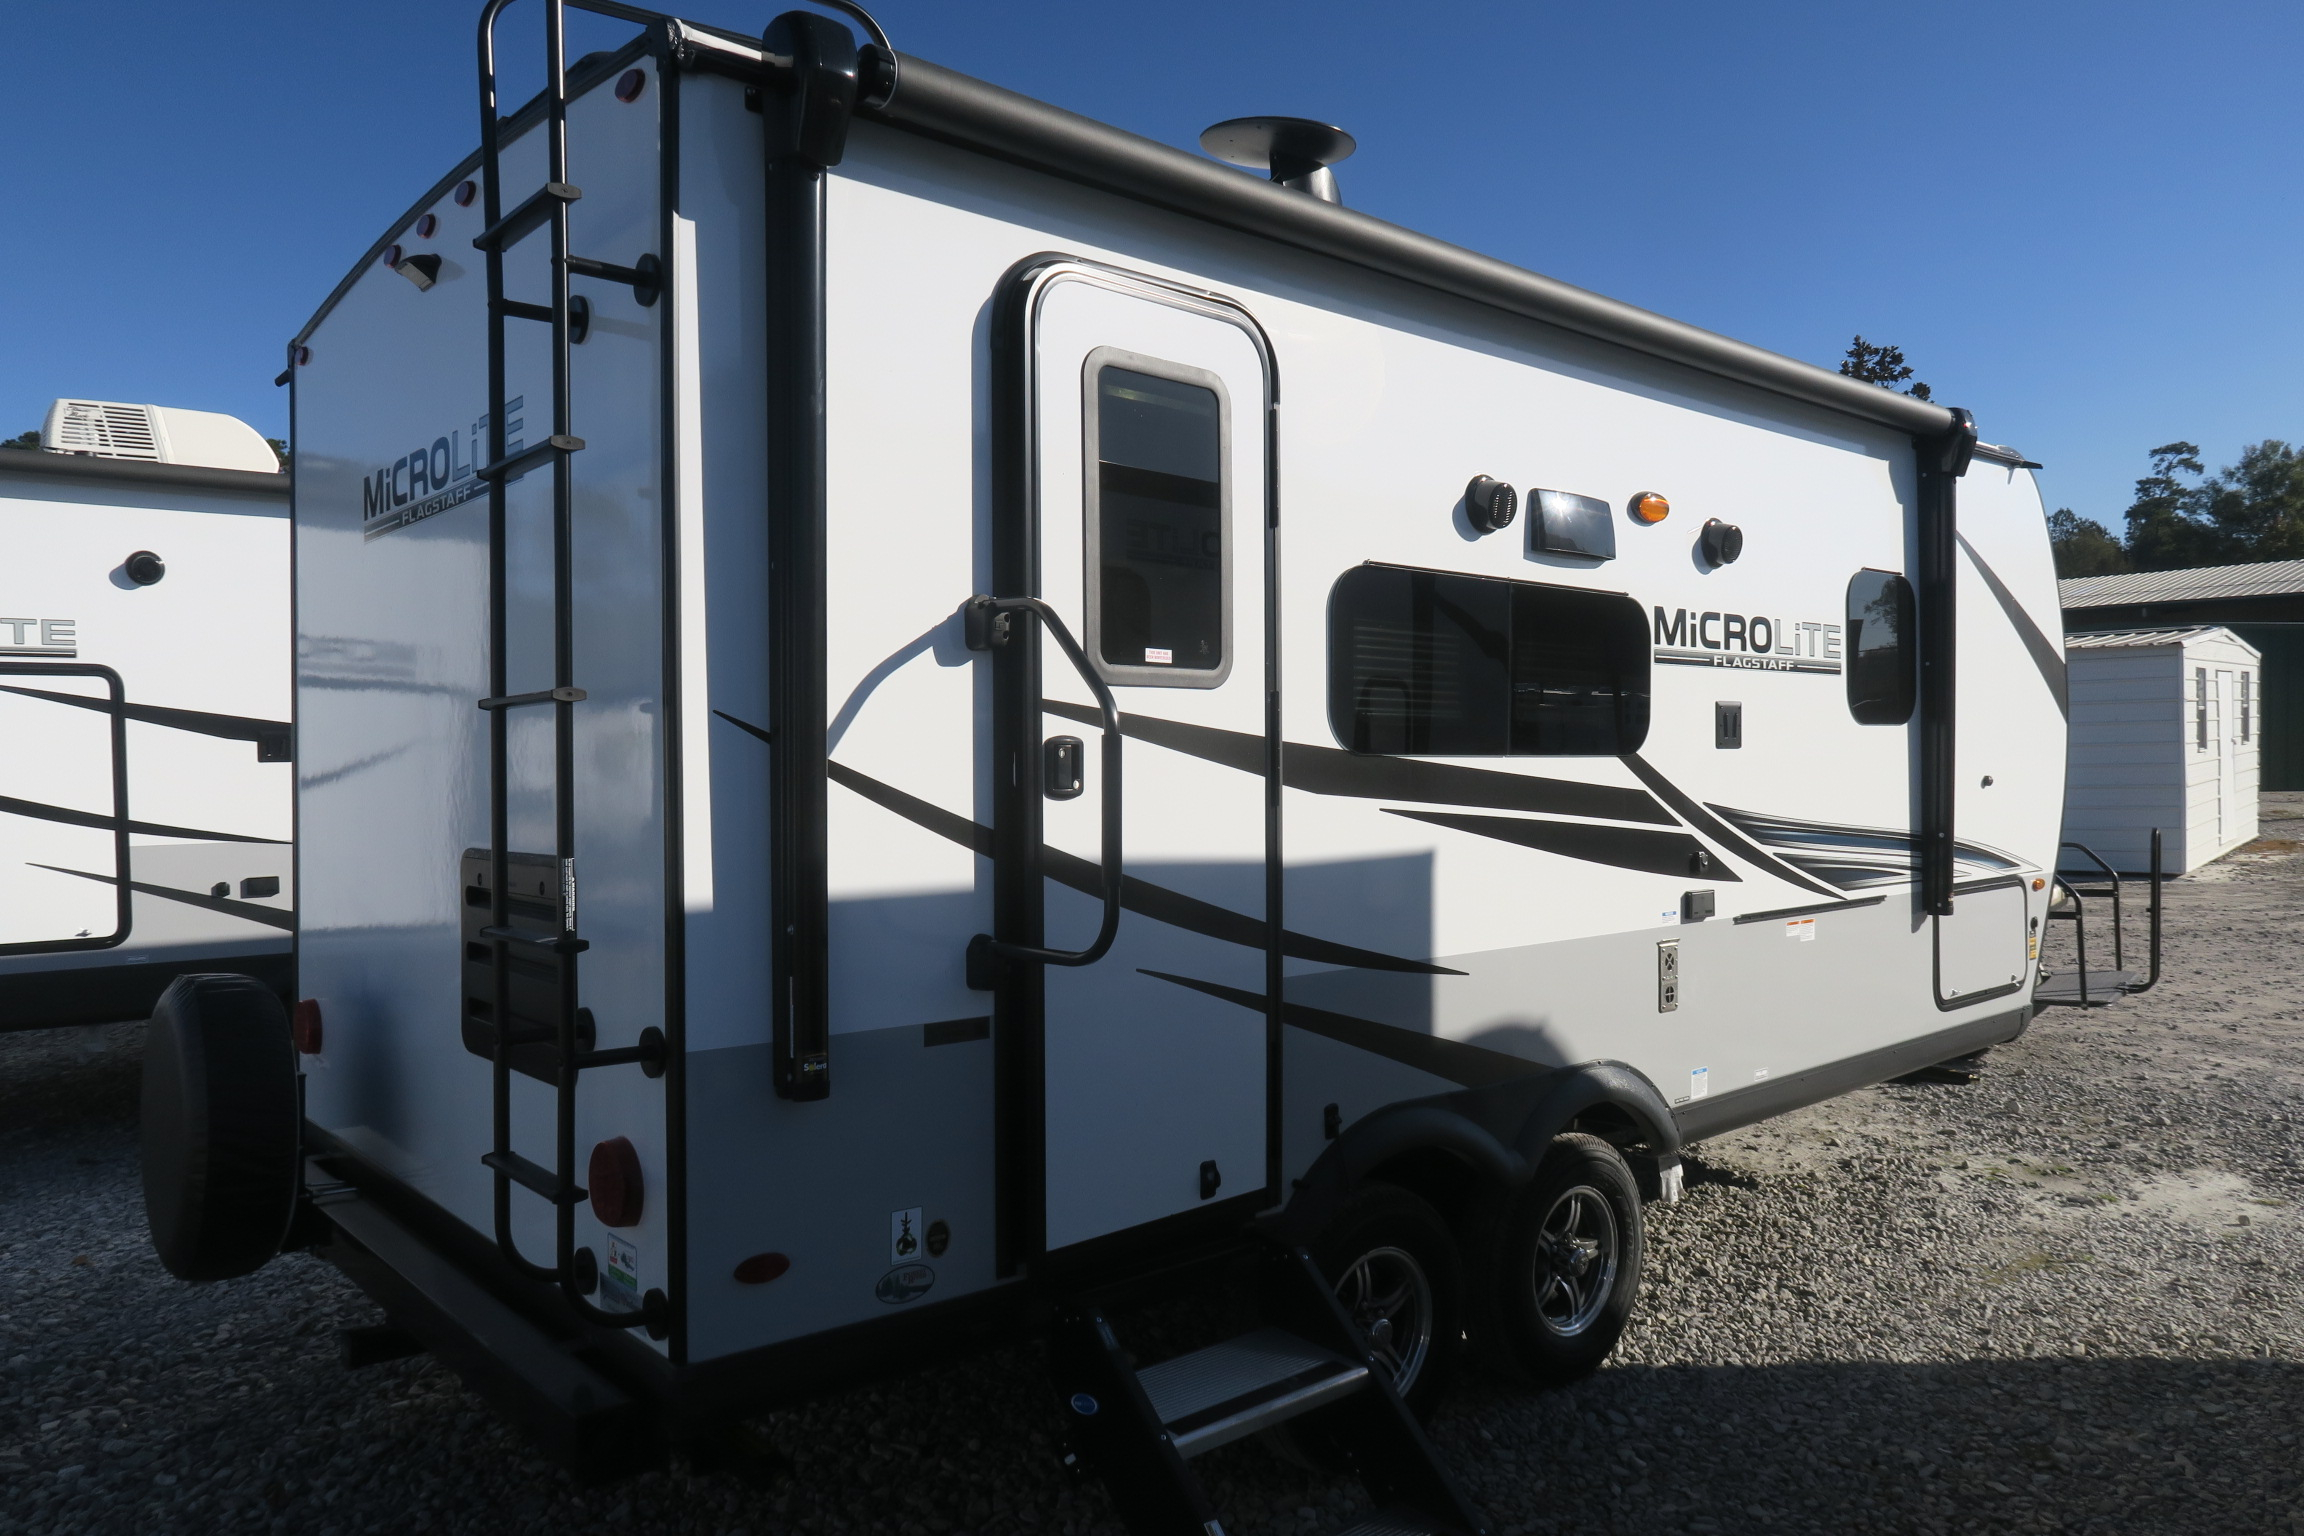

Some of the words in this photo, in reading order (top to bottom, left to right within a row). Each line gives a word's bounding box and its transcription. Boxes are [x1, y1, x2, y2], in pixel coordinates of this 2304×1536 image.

[402, 484, 472, 526] FLAGSTAFF
[1653, 605, 1841, 659] MiCROLiTE
[1713, 655, 1795, 671] FLAGSTAFF
